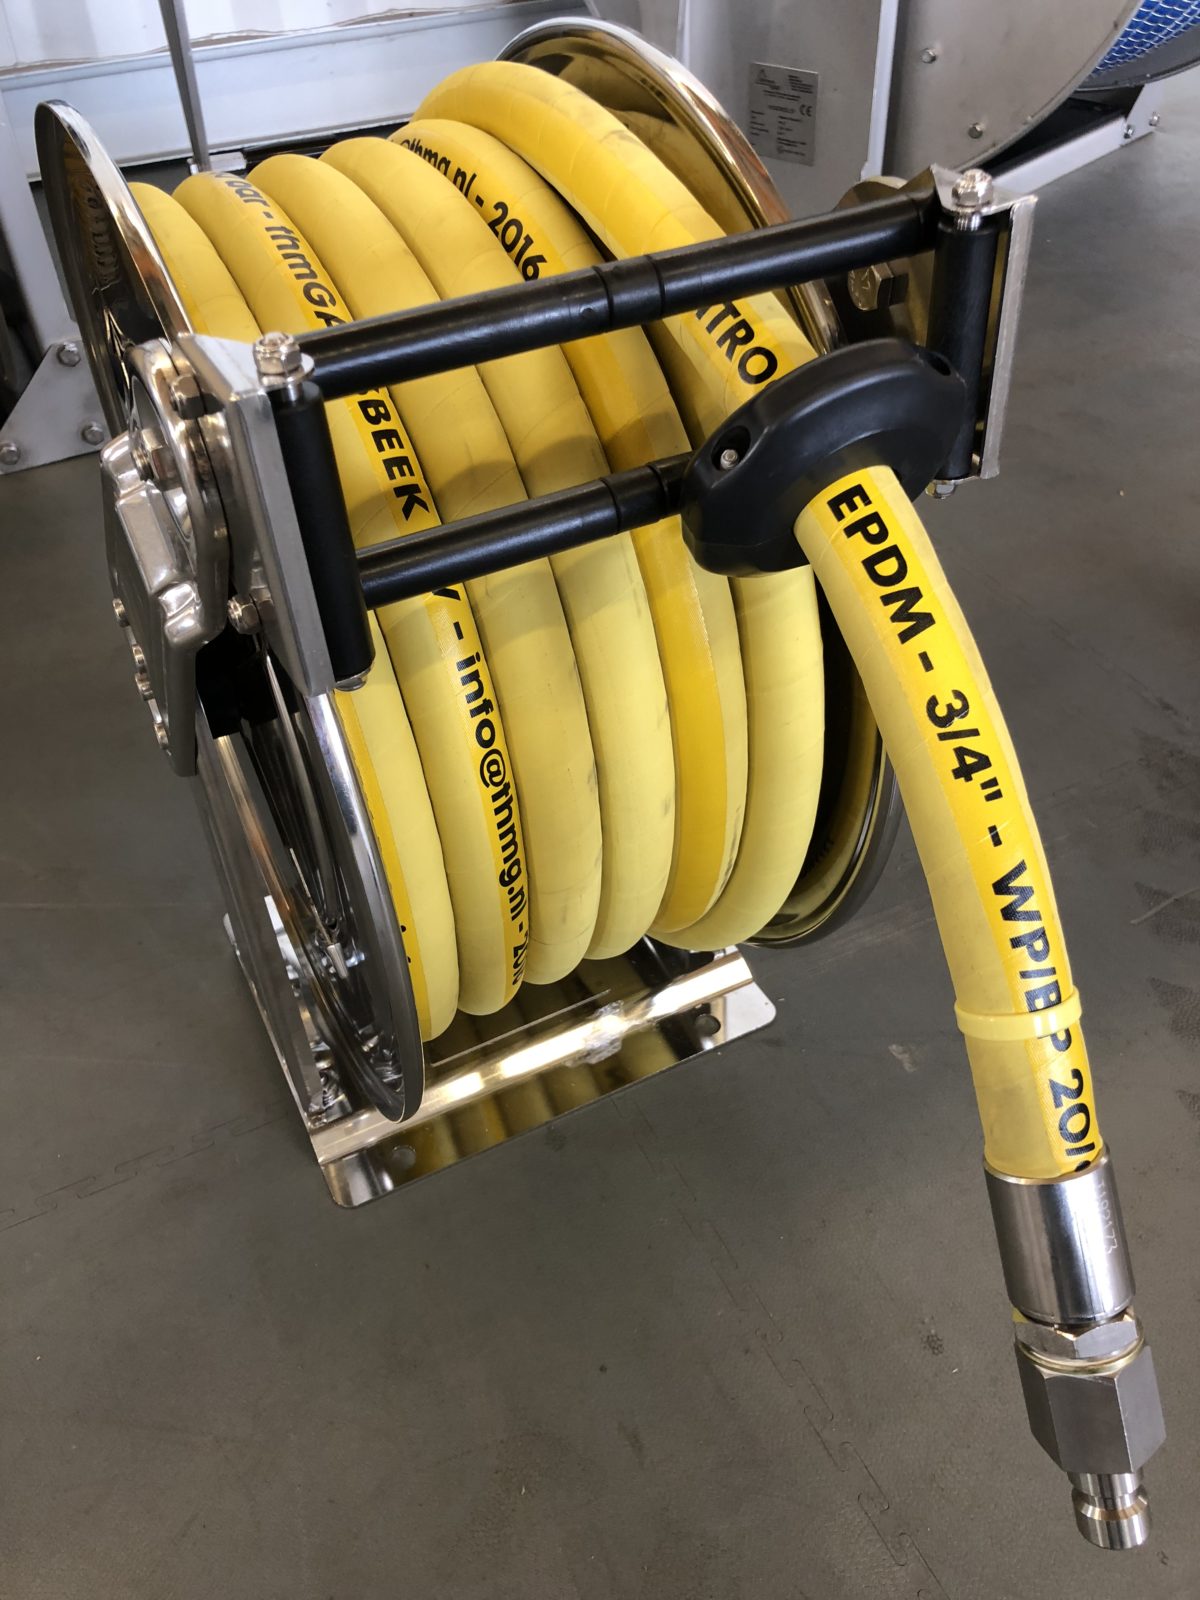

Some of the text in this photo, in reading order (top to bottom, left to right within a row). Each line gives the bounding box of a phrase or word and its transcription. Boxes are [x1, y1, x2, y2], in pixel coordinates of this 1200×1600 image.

[487, 201, 548, 282] 2016
[357, 388, 430, 522] BEEK
[455, 651, 527, 922] info@thmg.nl
[826, 483, 936, 645] EPDM
[925, 688, 1004, 803] 3/4"
